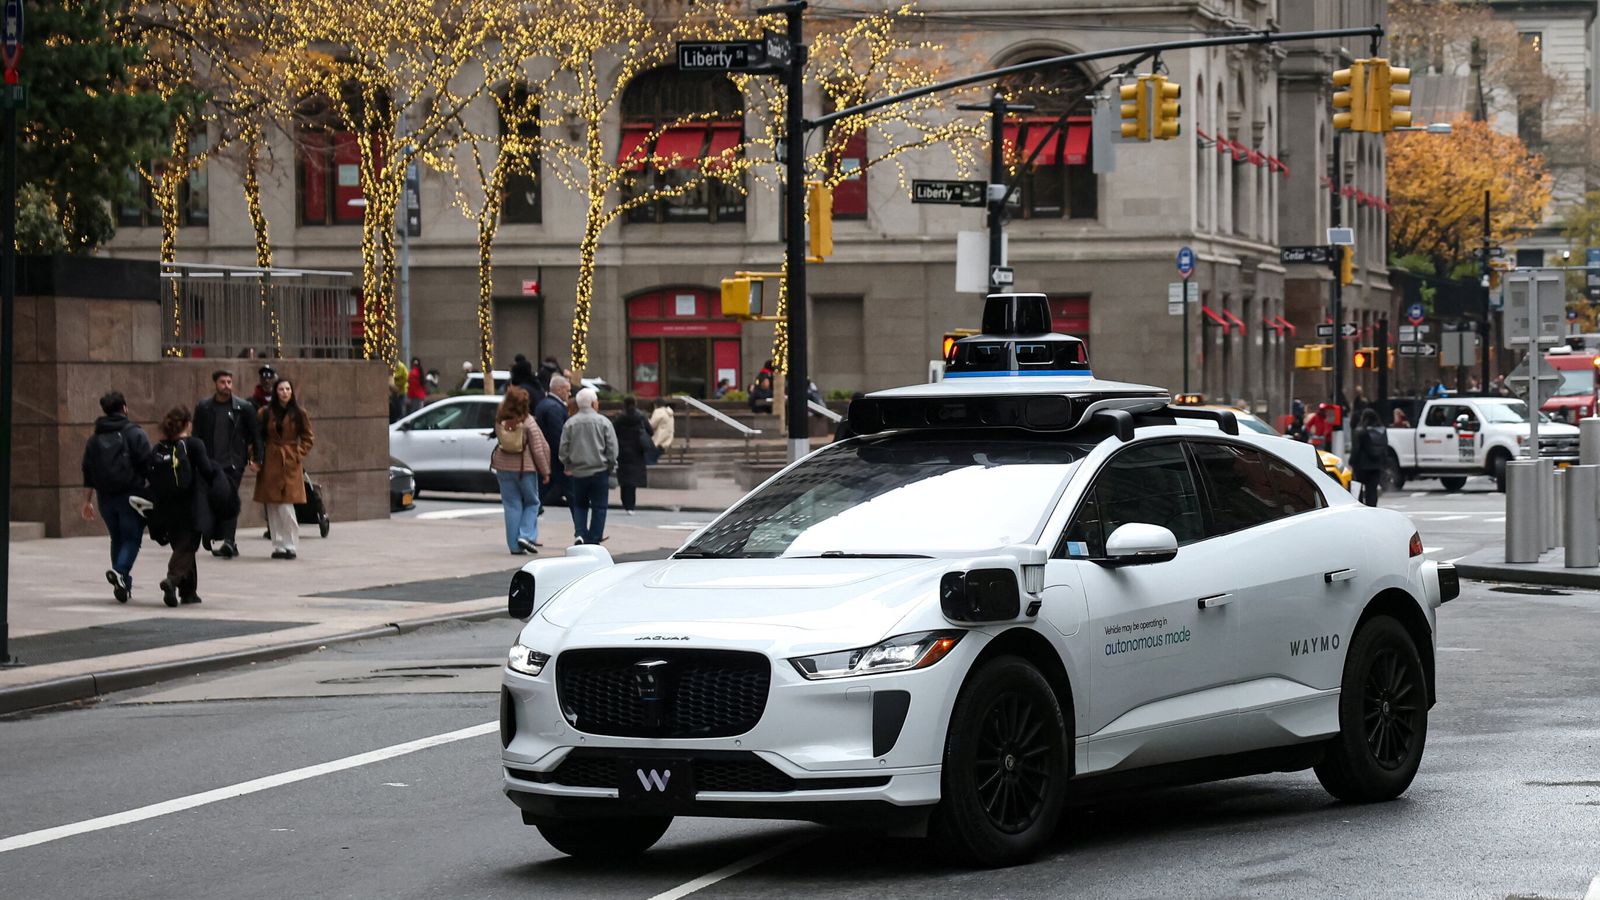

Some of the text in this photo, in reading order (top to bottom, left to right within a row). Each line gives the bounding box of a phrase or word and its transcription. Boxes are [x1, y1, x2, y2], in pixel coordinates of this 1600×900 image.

[684, 50, 732, 68] Liberty
[917, 187, 953, 201] Liberty
[1104, 617, 1168, 635] Vehicle may be operating in
[1105, 625, 1191, 656] autonomous mode
[1289, 633, 1340, 656] WAYMO
